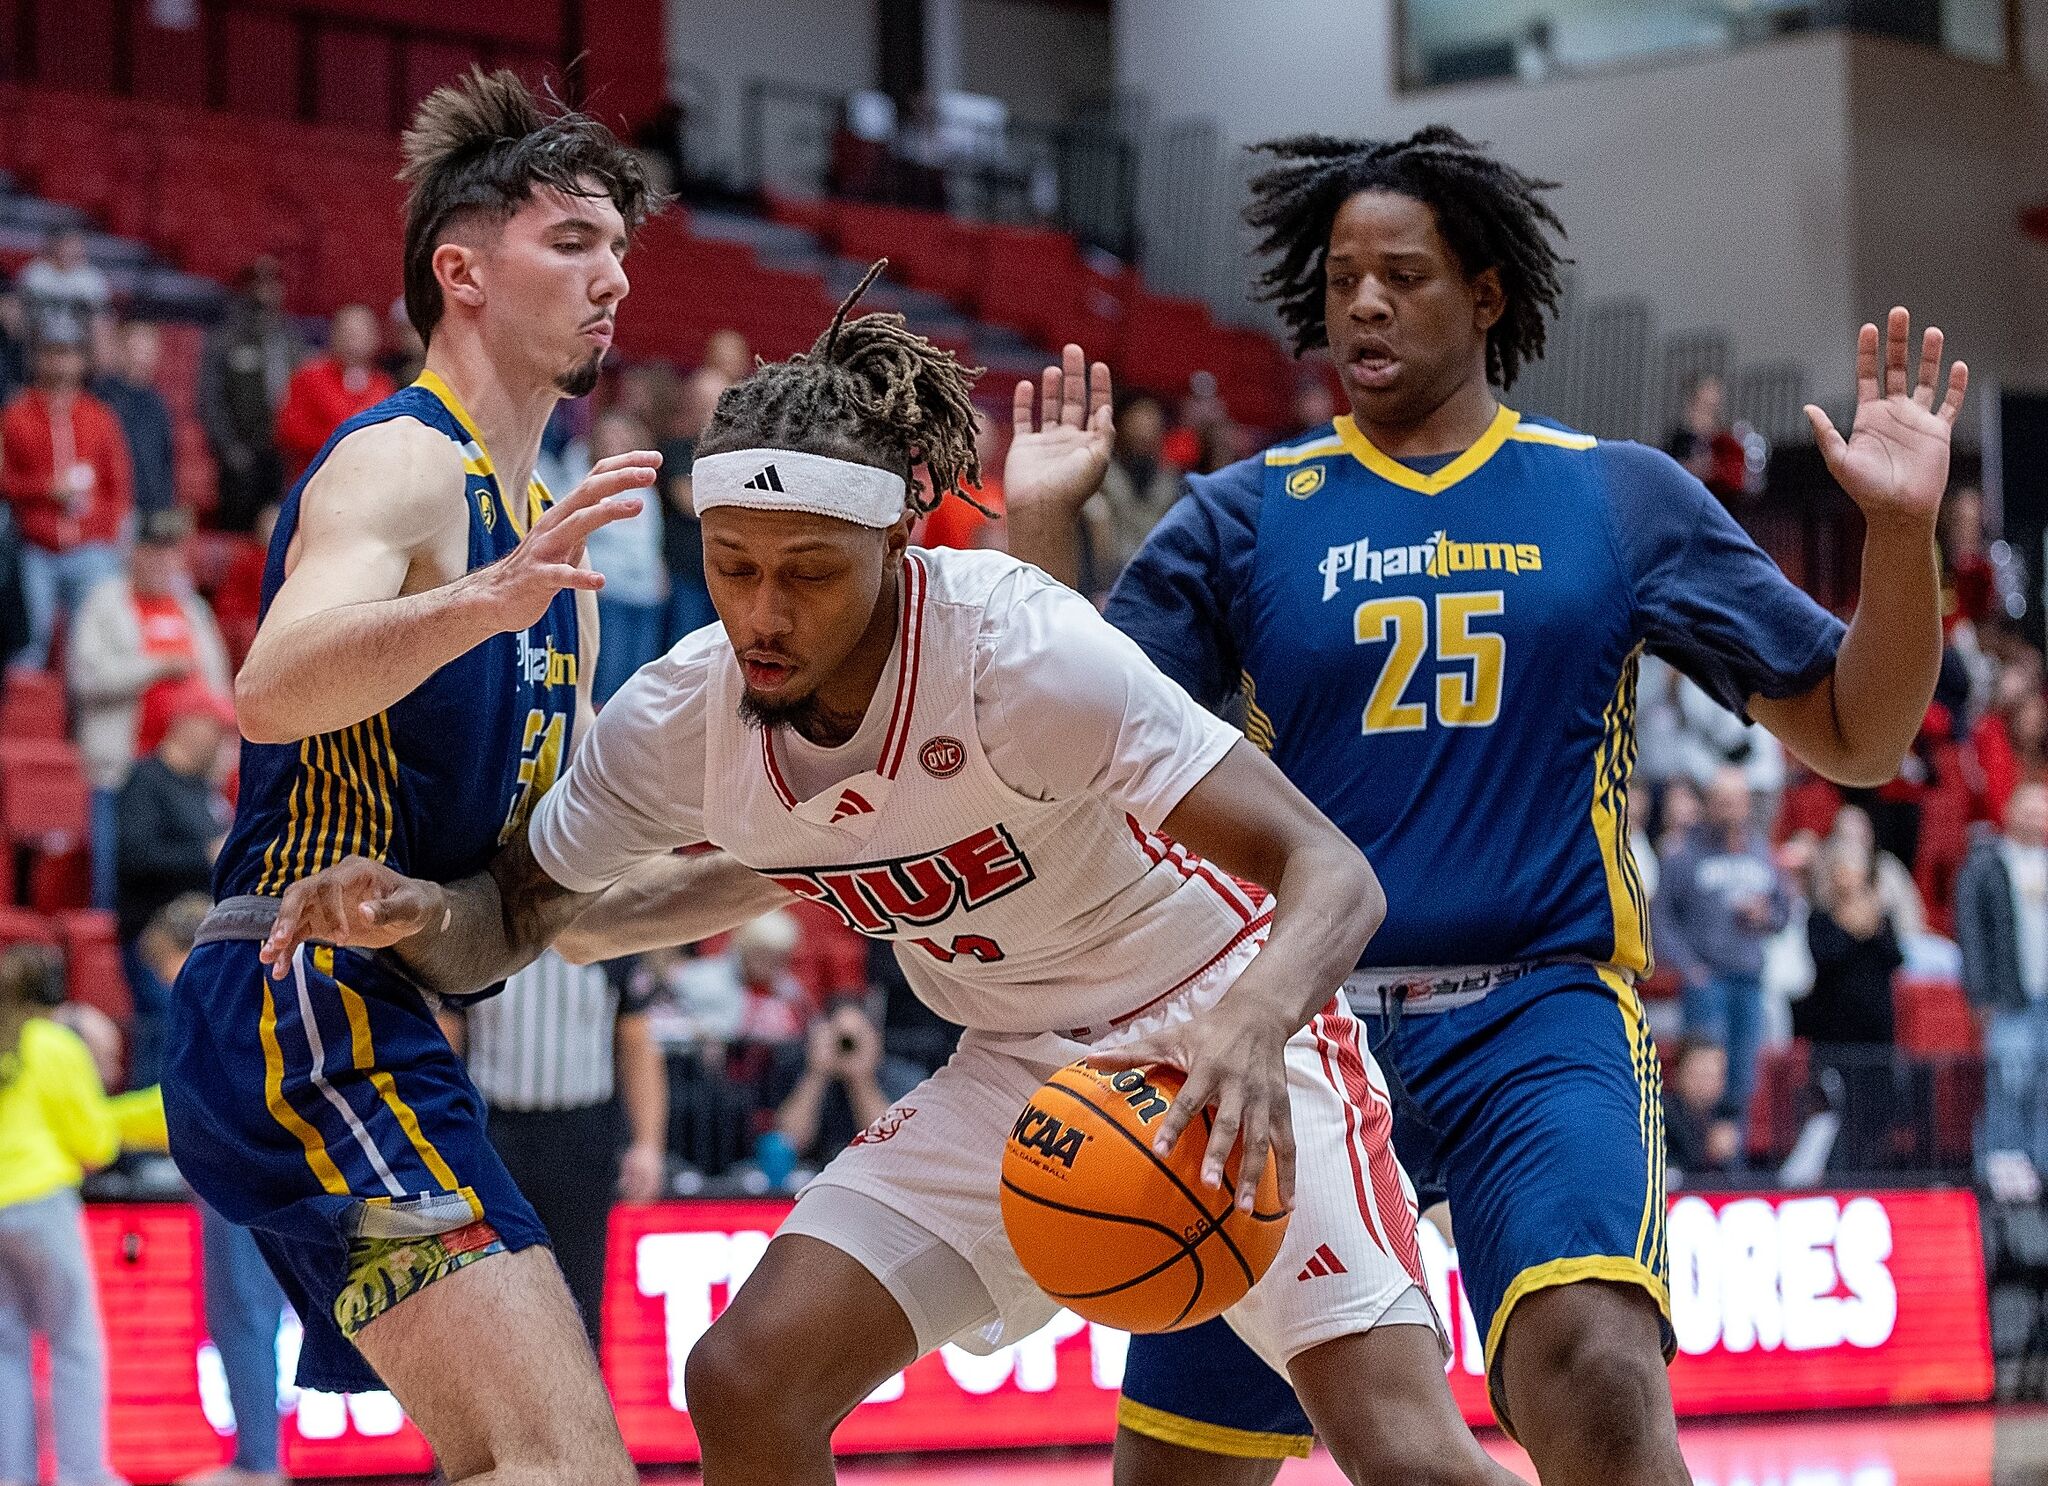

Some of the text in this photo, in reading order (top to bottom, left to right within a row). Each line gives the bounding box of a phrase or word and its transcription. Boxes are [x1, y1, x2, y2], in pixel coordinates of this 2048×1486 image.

[1318, 529, 1542, 602] Phantoms
[1353, 590, 1506, 736] 25
[927, 747, 956, 768] OVC
